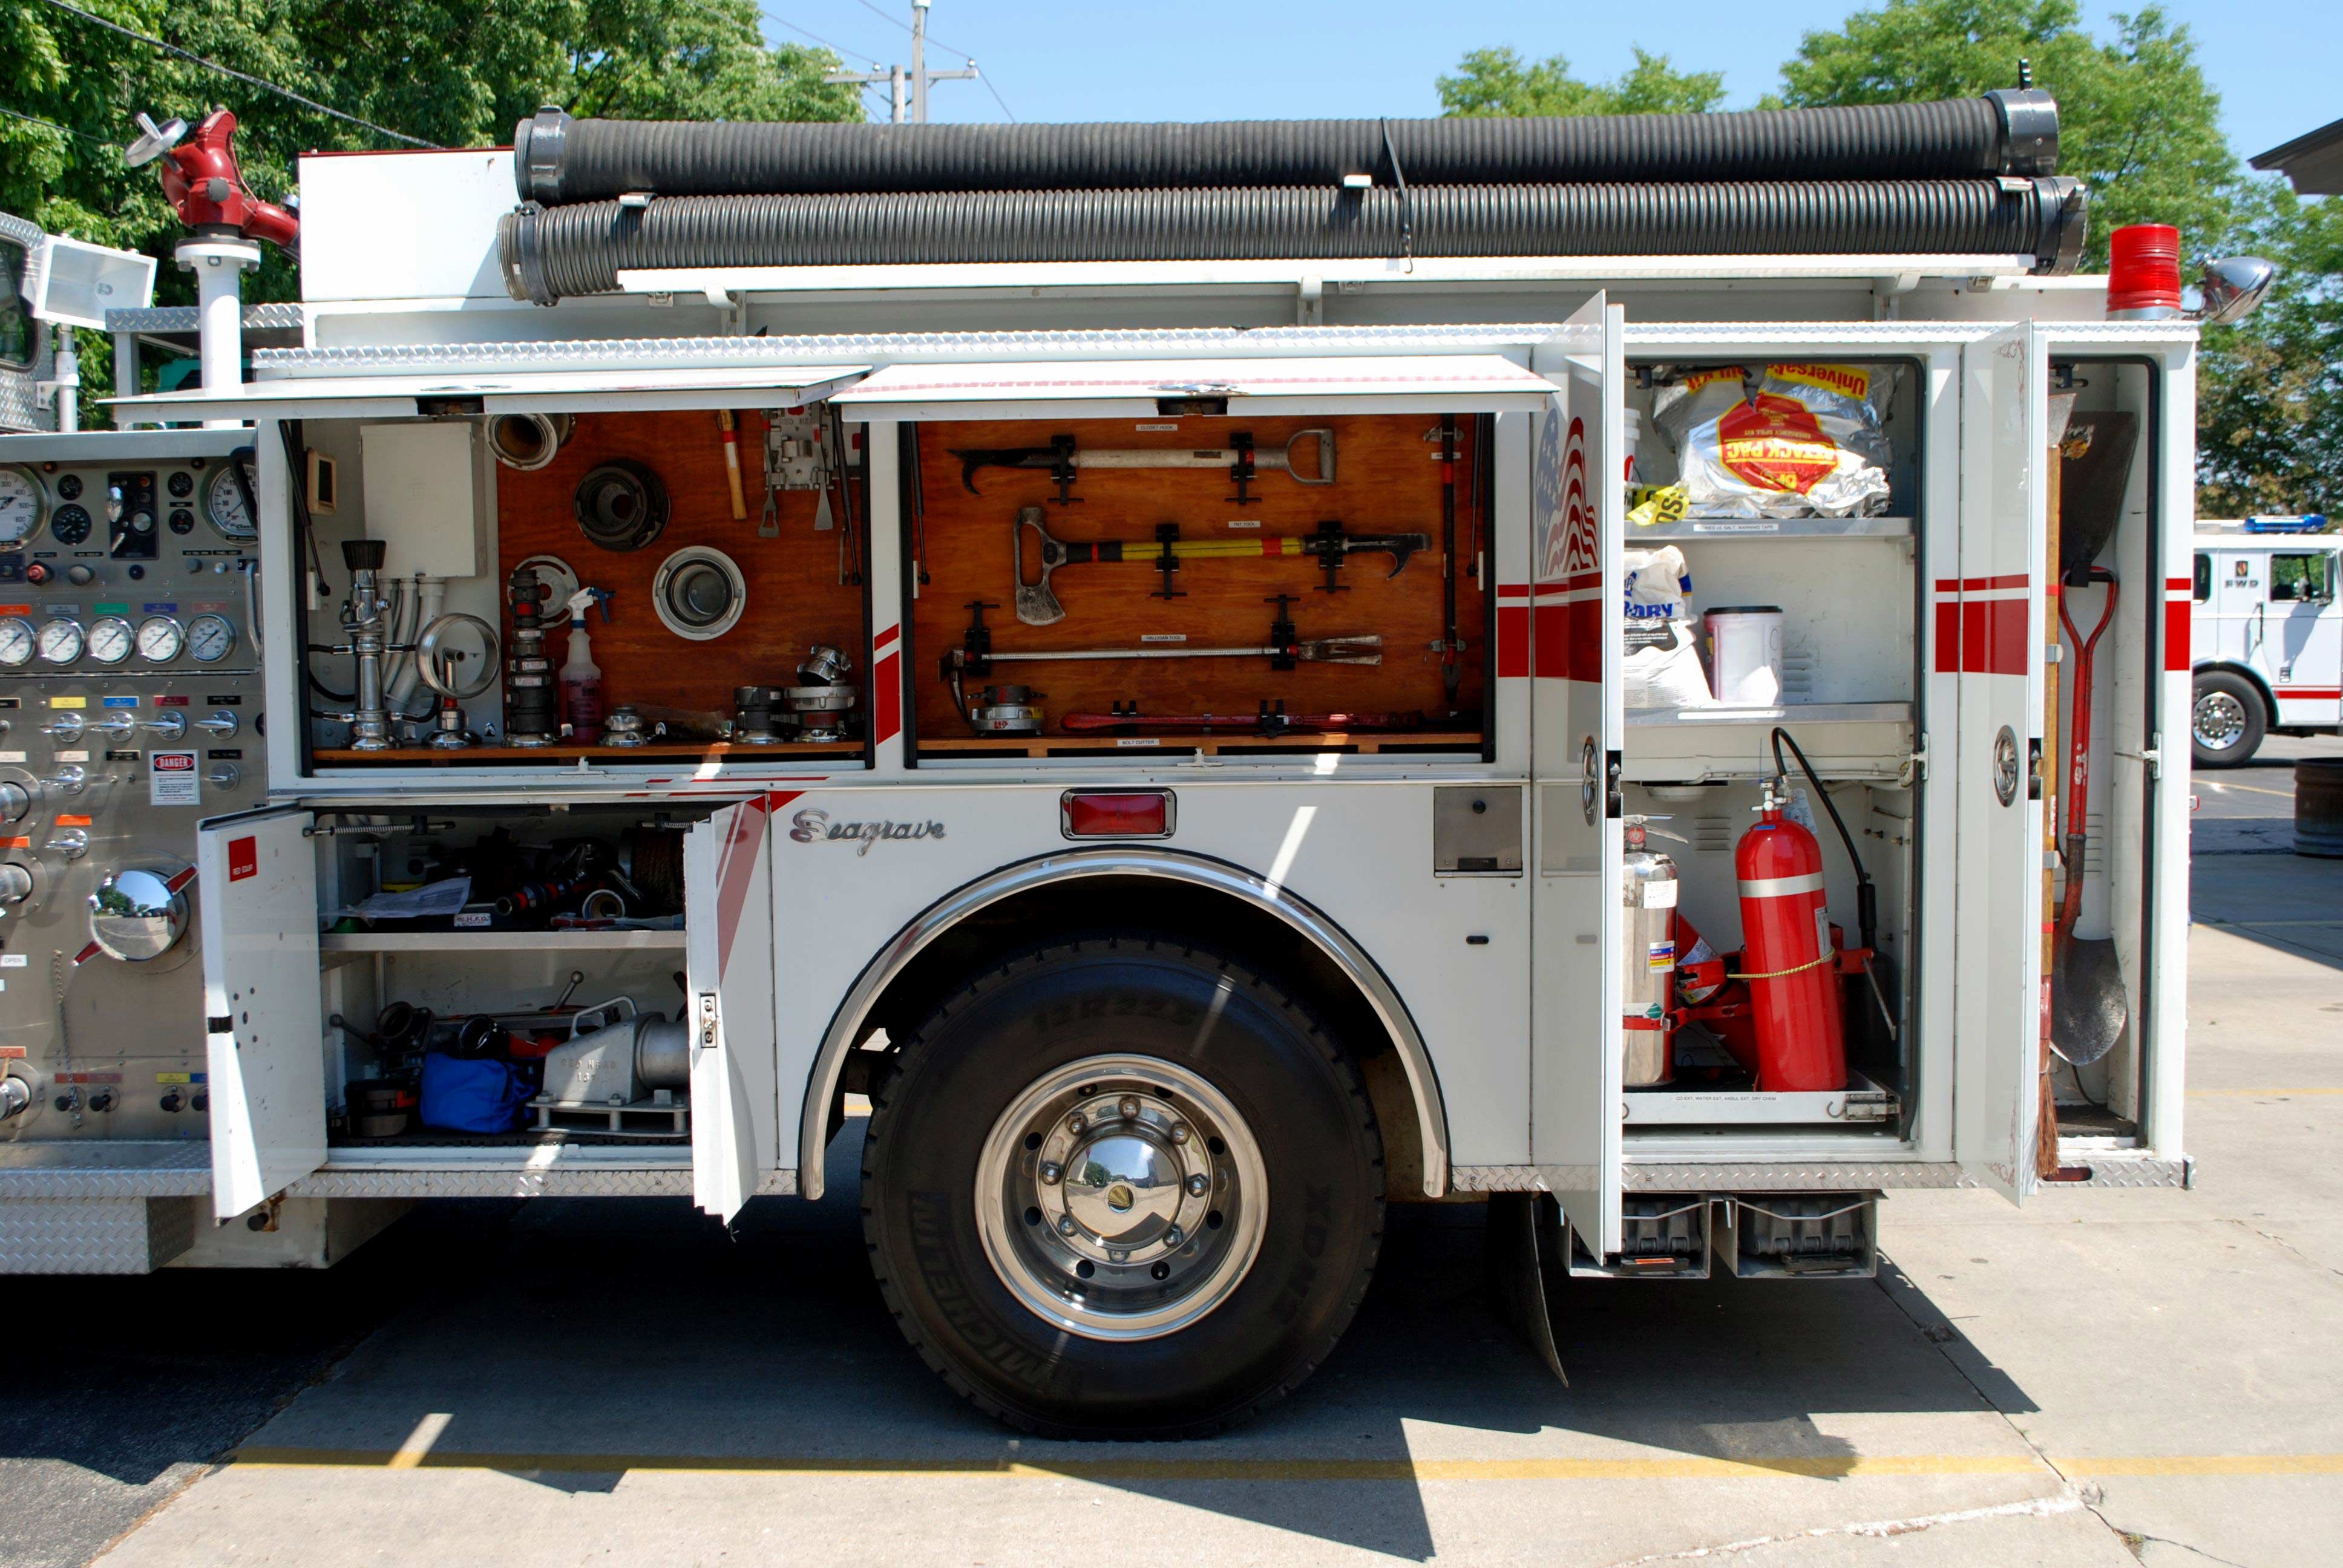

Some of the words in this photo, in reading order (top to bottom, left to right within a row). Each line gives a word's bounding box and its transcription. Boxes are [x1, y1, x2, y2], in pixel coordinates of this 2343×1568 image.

[1774, 430, 1811, 439] EMERGENCY
[1726, 440, 1763, 459] PAC
[1766, 439, 1835, 460] ATTACK
[2225, 580, 2258, 589] FWD
[160, 757, 188, 768] DANGER
[789, 808, 946, 857] Seagrave
[561, 1058, 582, 1069] RED
[588, 1059, 617, 1070] HEAD
[910, 1195, 1050, 1384] MICHELIN
